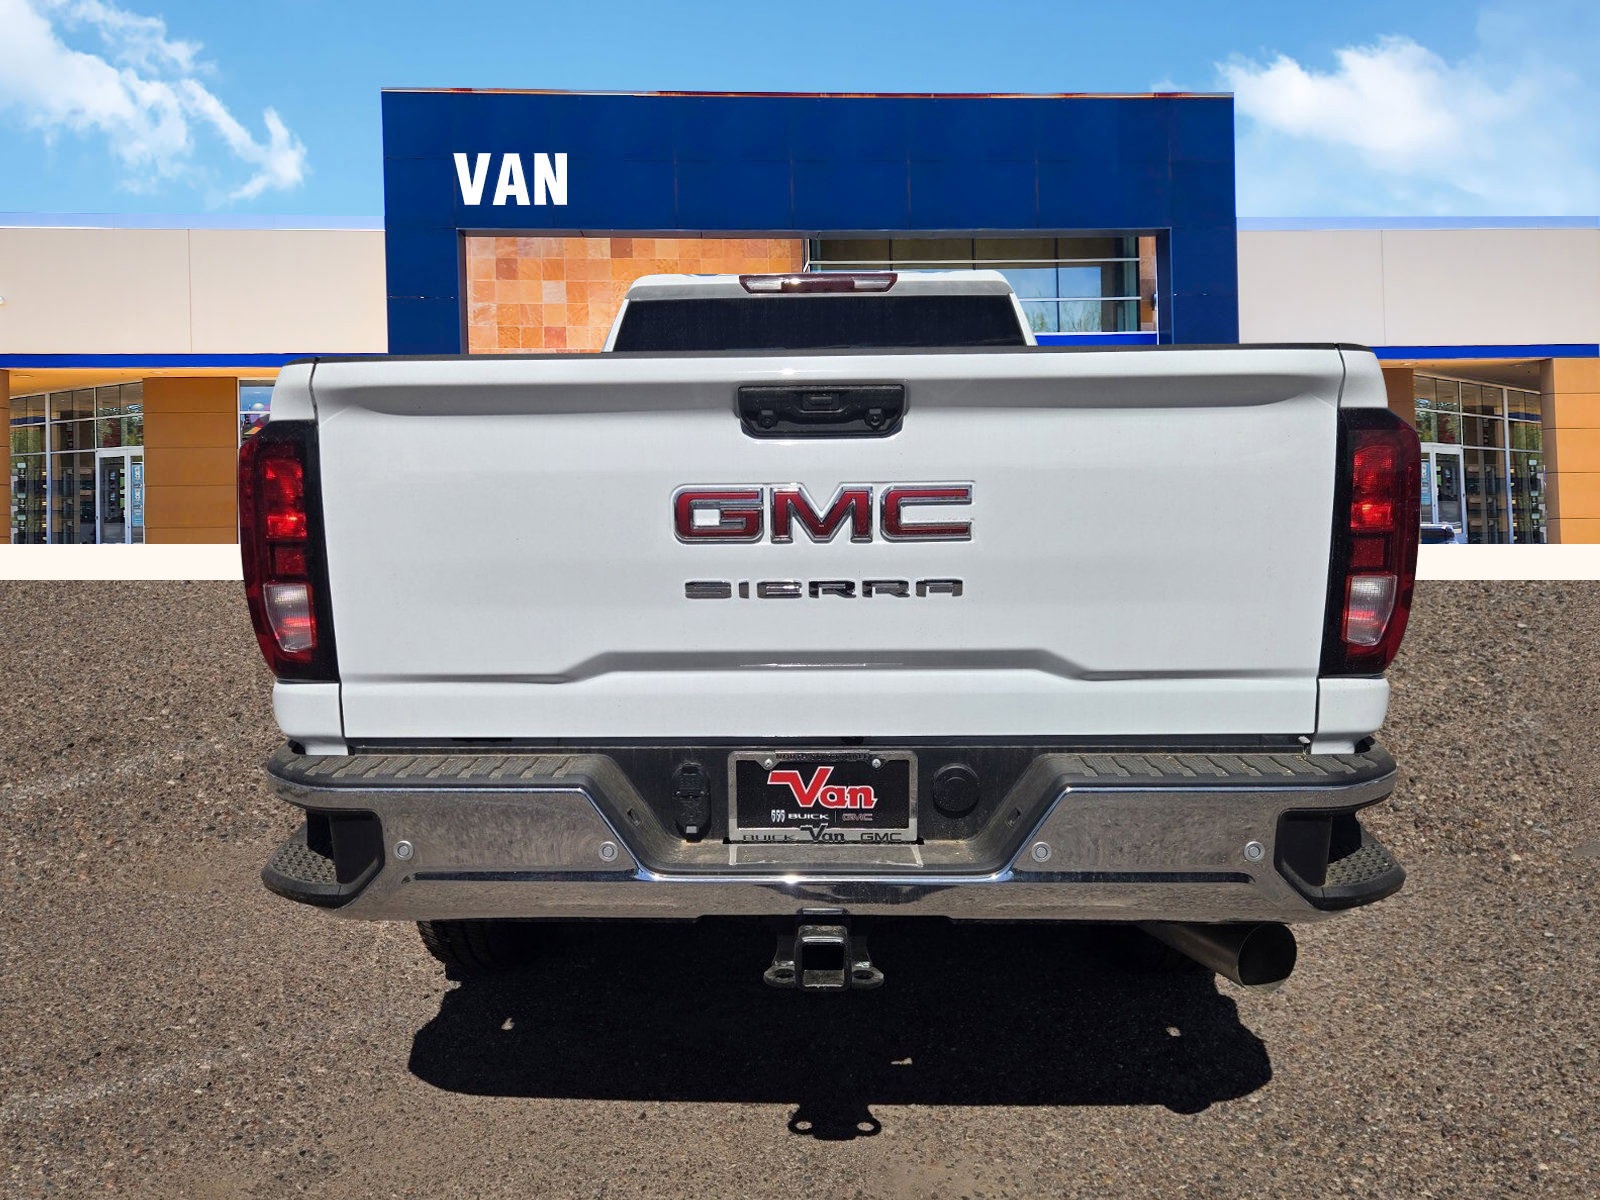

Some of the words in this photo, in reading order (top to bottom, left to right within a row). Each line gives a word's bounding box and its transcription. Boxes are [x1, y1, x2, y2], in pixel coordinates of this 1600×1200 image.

[453, 153, 568, 206] VAN
[672, 481, 975, 544] GMC
[684, 579, 964, 600] SIERRA
[767, 766, 878, 808] Van
[788, 812, 830, 820] BUICK
[842, 813, 873, 821] GMC
[800, 823, 845, 842] Van
[860, 832, 902, 841] GMC
